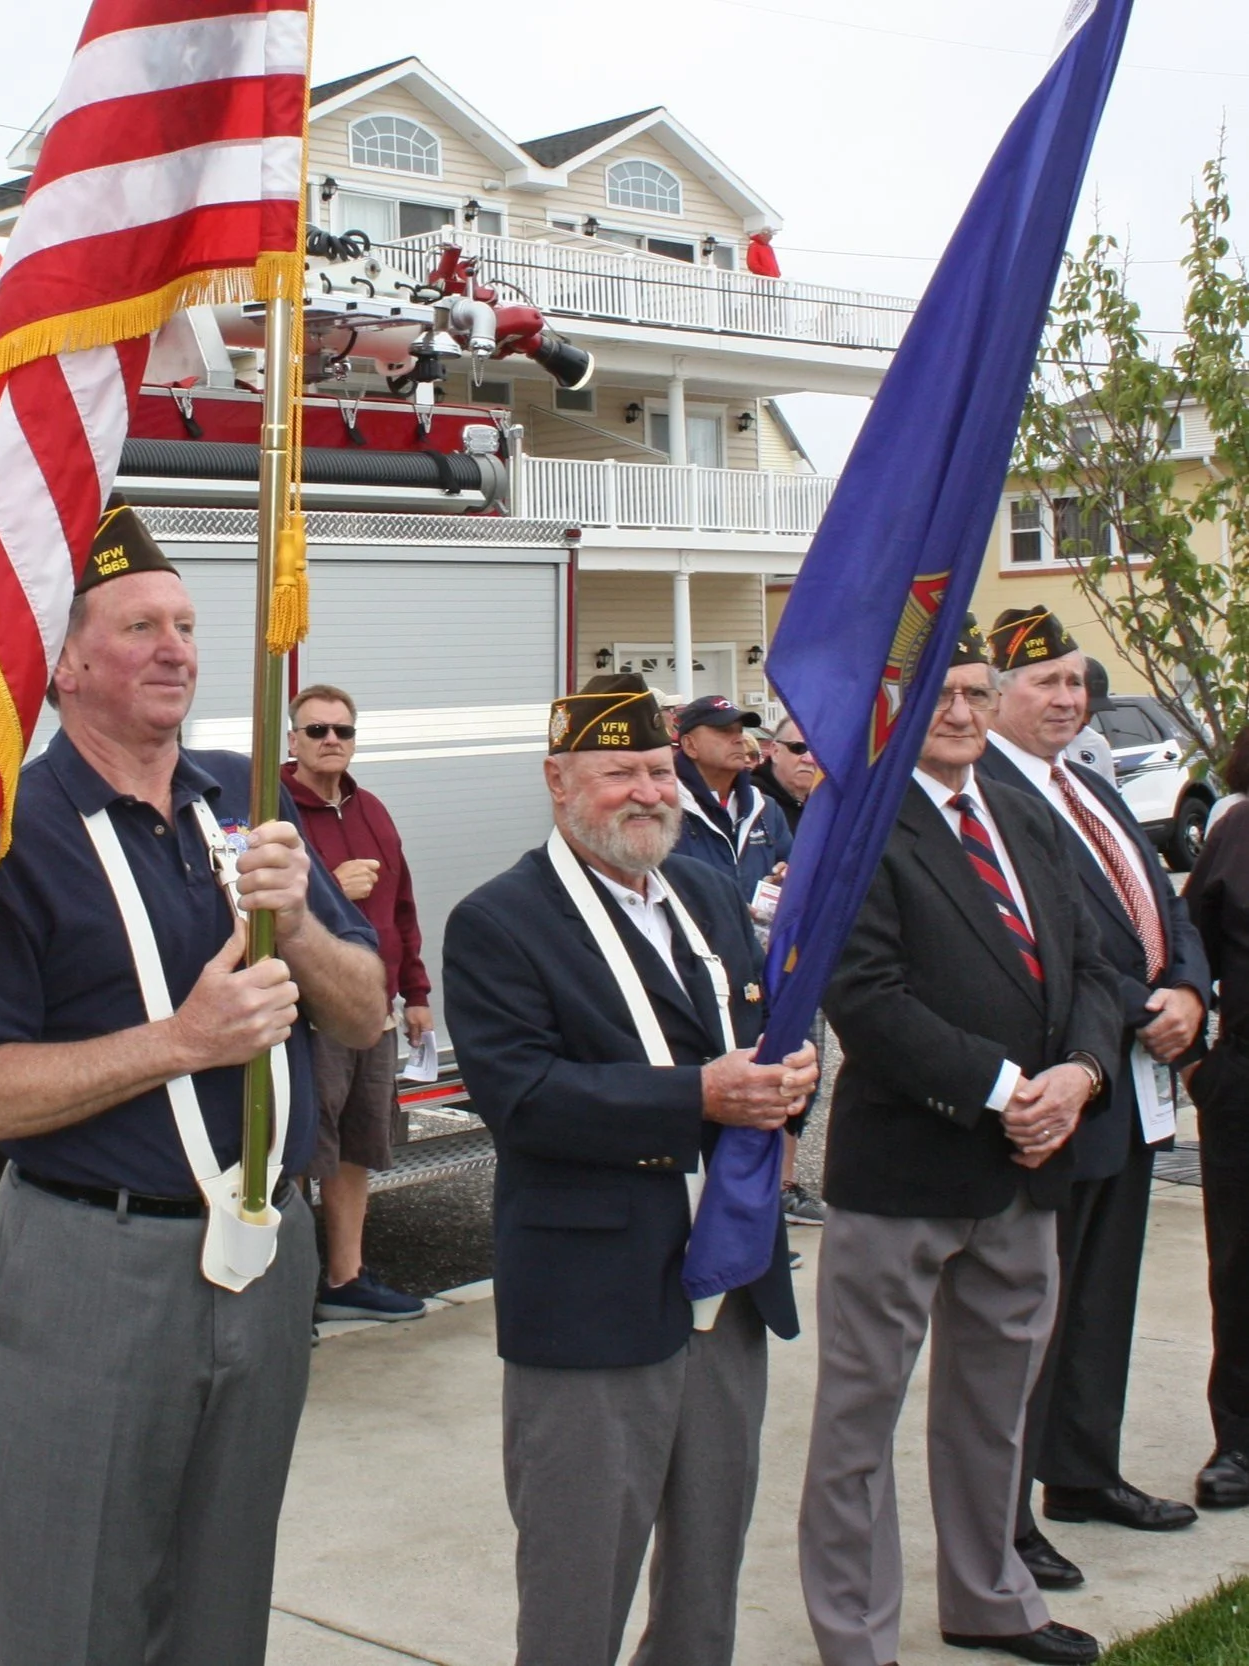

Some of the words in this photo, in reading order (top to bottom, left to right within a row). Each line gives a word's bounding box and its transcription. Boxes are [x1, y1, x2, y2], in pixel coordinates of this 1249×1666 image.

[94, 545, 124, 566] VFW
[98, 557, 129, 576] 1963
[601, 722, 628, 733] VFW
[597, 734, 630, 746] 1963
